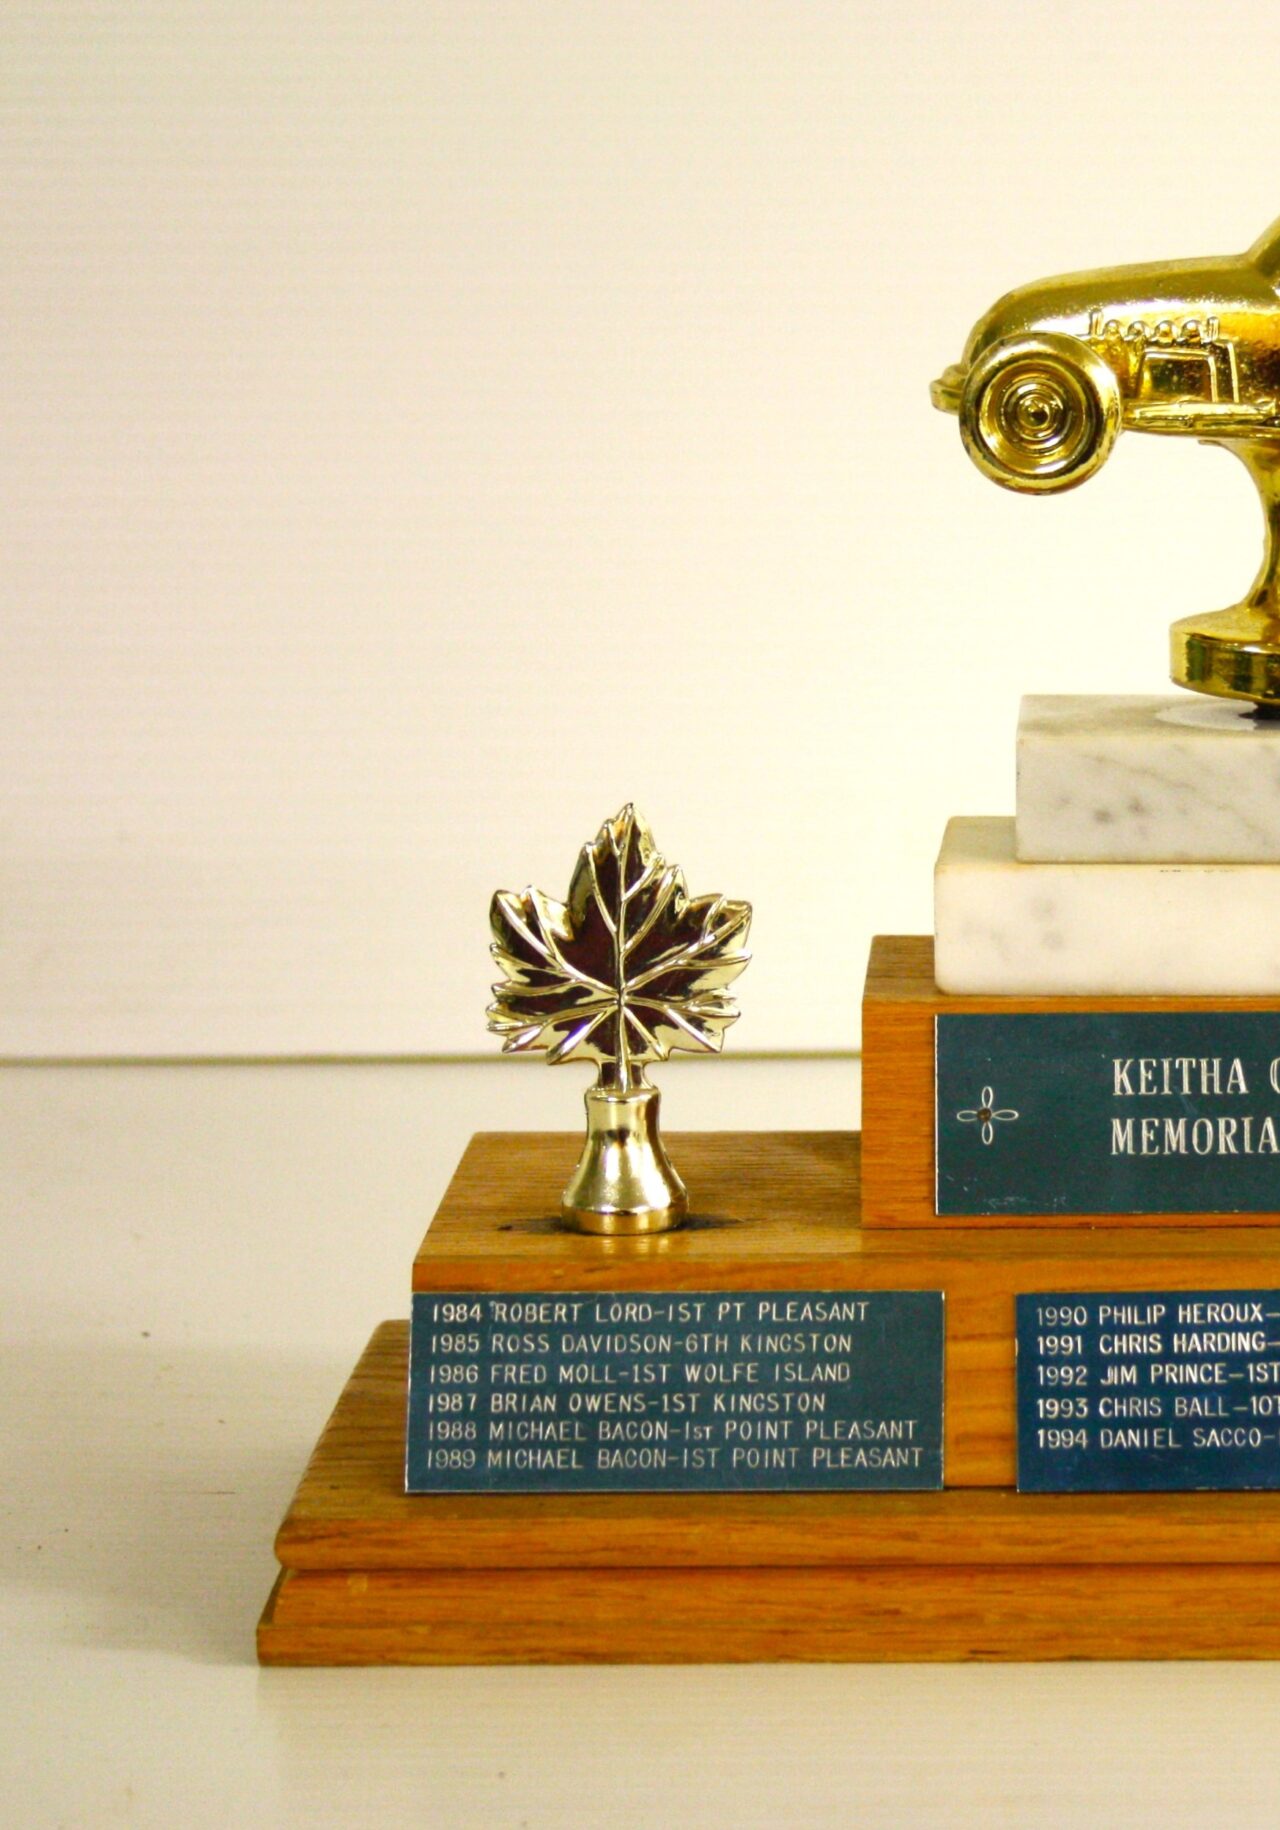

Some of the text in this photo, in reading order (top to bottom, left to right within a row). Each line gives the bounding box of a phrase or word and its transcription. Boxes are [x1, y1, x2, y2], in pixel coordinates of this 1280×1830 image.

[1111, 1056, 1250, 1097] KEITHA
[432, 1303, 483, 1323] 1984
[494, 1303, 583, 1324] ROBERT
[717, 1301, 746, 1322] PT
[758, 1301, 870, 1322] PLEASANT
[1036, 1305, 1089, 1327] 1990
[1098, 1303, 1167, 1327] PHILIP
[431, 1333, 481, 1354] 1985
[491, 1333, 550, 1354] ROSS
[740, 1332, 852, 1354] KINGSTON
[1036, 1334, 1083, 1356] 1991
[1098, 1332, 1164, 1356] CHRIS
[429, 1363, 479, 1385] 1986
[490, 1363, 548, 1385] FRED
[684, 1362, 759, 1384] WOLFE
[774, 1362, 851, 1383] ISLAND
[1036, 1363, 1089, 1387] 1992
[1099, 1364, 1138, 1387] JIM
[428, 1392, 477, 1414] 1987
[490, 1392, 557, 1414] BRIAN
[713, 1392, 826, 1413] KINGSTON
[1036, 1397, 1090, 1420] 1993
[1097, 1396, 1163, 1419] CHRIS
[428, 1420, 477, 1441] 1988
[488, 1420, 587, 1442] MICHAEL
[724, 1419, 793, 1441] POINT
[805, 1419, 918, 1441] PLEASANT
[1036, 1427, 1089, 1450] 1994
[1099, 1427, 1182, 1450] DANIEL
[427, 1448, 477, 1470] 1989
[487, 1448, 584, 1470] MICHAEL
[731, 1447, 800, 1469] POINT
[812, 1446, 924, 1469] PLEASANT
